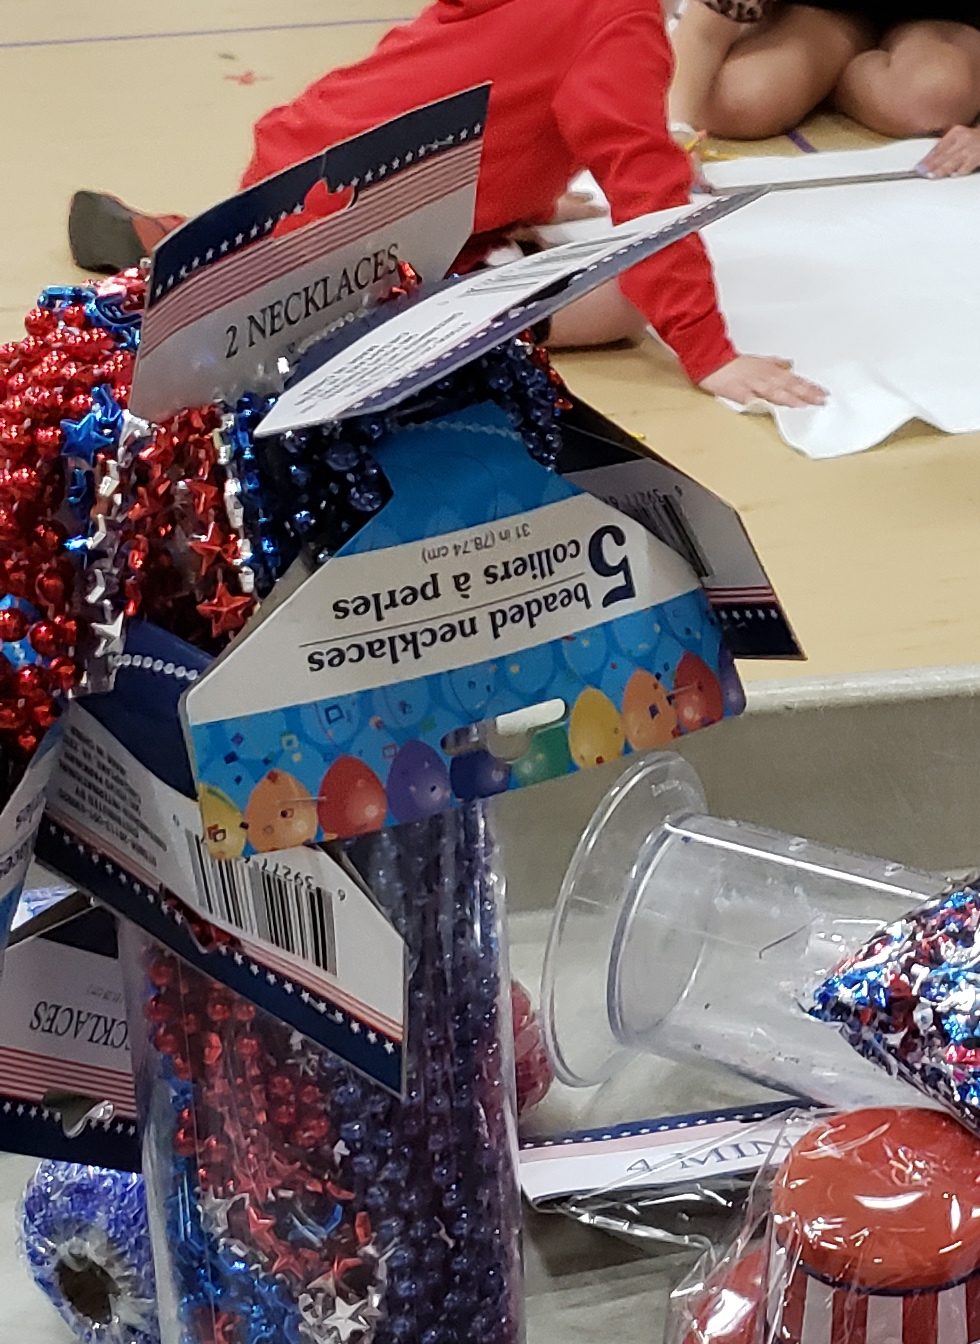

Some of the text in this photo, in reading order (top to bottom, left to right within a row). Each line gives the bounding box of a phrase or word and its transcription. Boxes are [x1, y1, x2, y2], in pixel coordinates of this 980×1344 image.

[225, 243, 400, 359] 2 NECKLACES
[499, 528, 510, 543] in
[514, 522, 531, 539] 31
[332, 538, 581, 623] colliers à perles
[588, 524, 636, 609] 5
[307, 582, 591, 674] beaded necklaces
[29, 1001, 131, 1051] CKLACES
[671, 1136, 794, 1170] MIN
